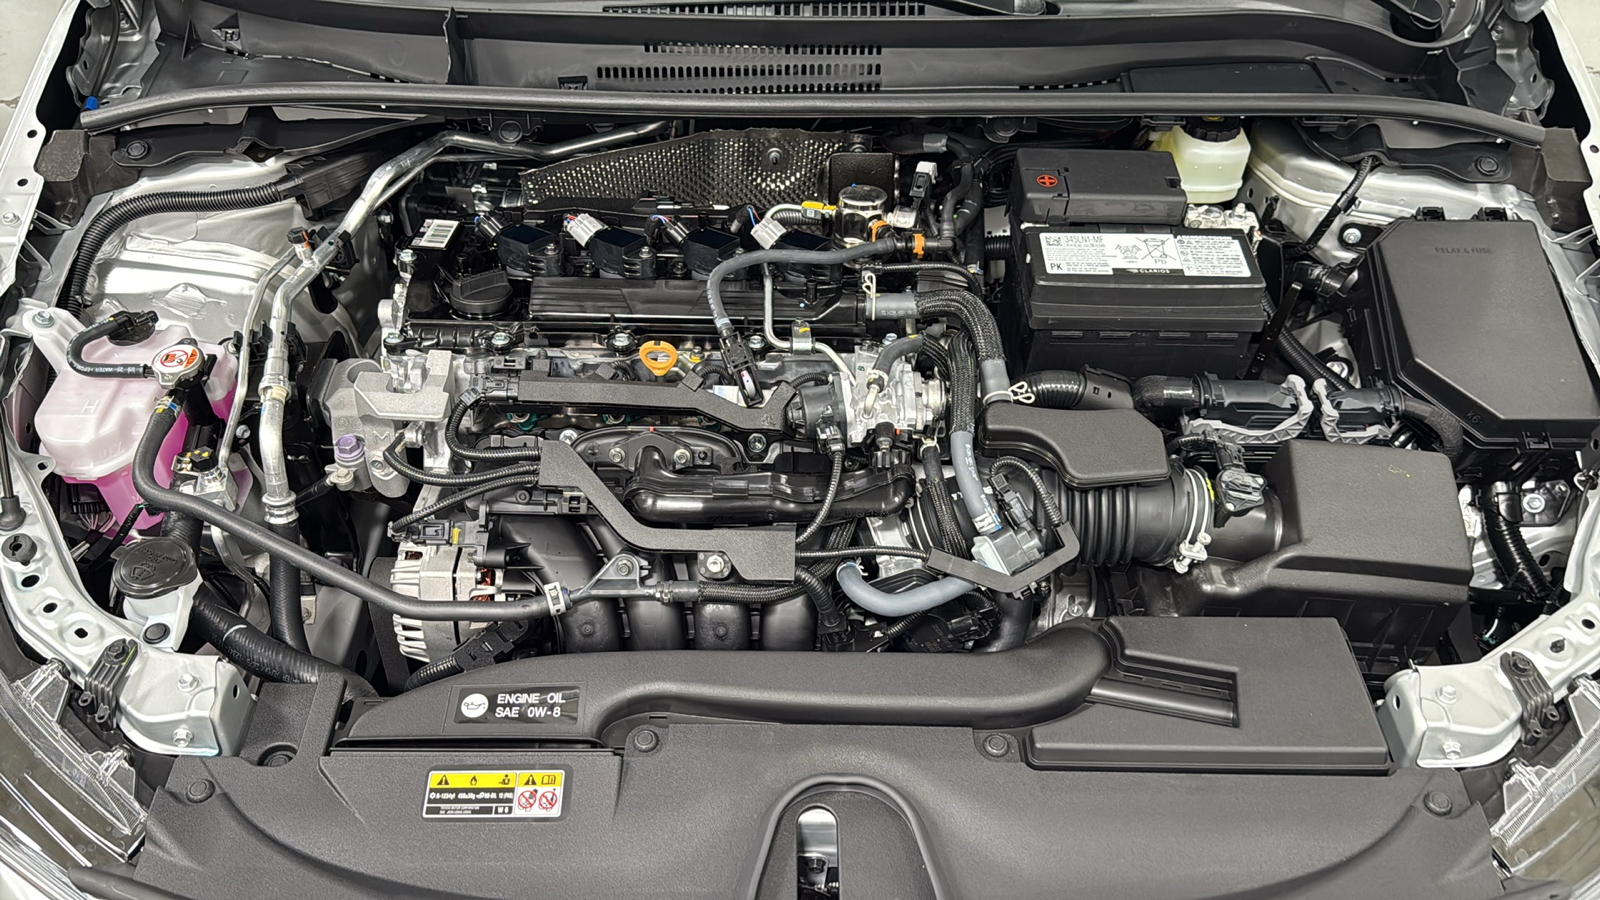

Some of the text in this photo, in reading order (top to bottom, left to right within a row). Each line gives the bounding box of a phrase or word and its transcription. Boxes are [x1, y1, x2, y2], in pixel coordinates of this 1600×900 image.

[1064, 235, 1103, 244] 345LN1-MF
[1050, 262, 1063, 271] PK
[496, 692, 566, 704] ENGINE OIL
[494, 706, 561, 718] SAE 0W-8
